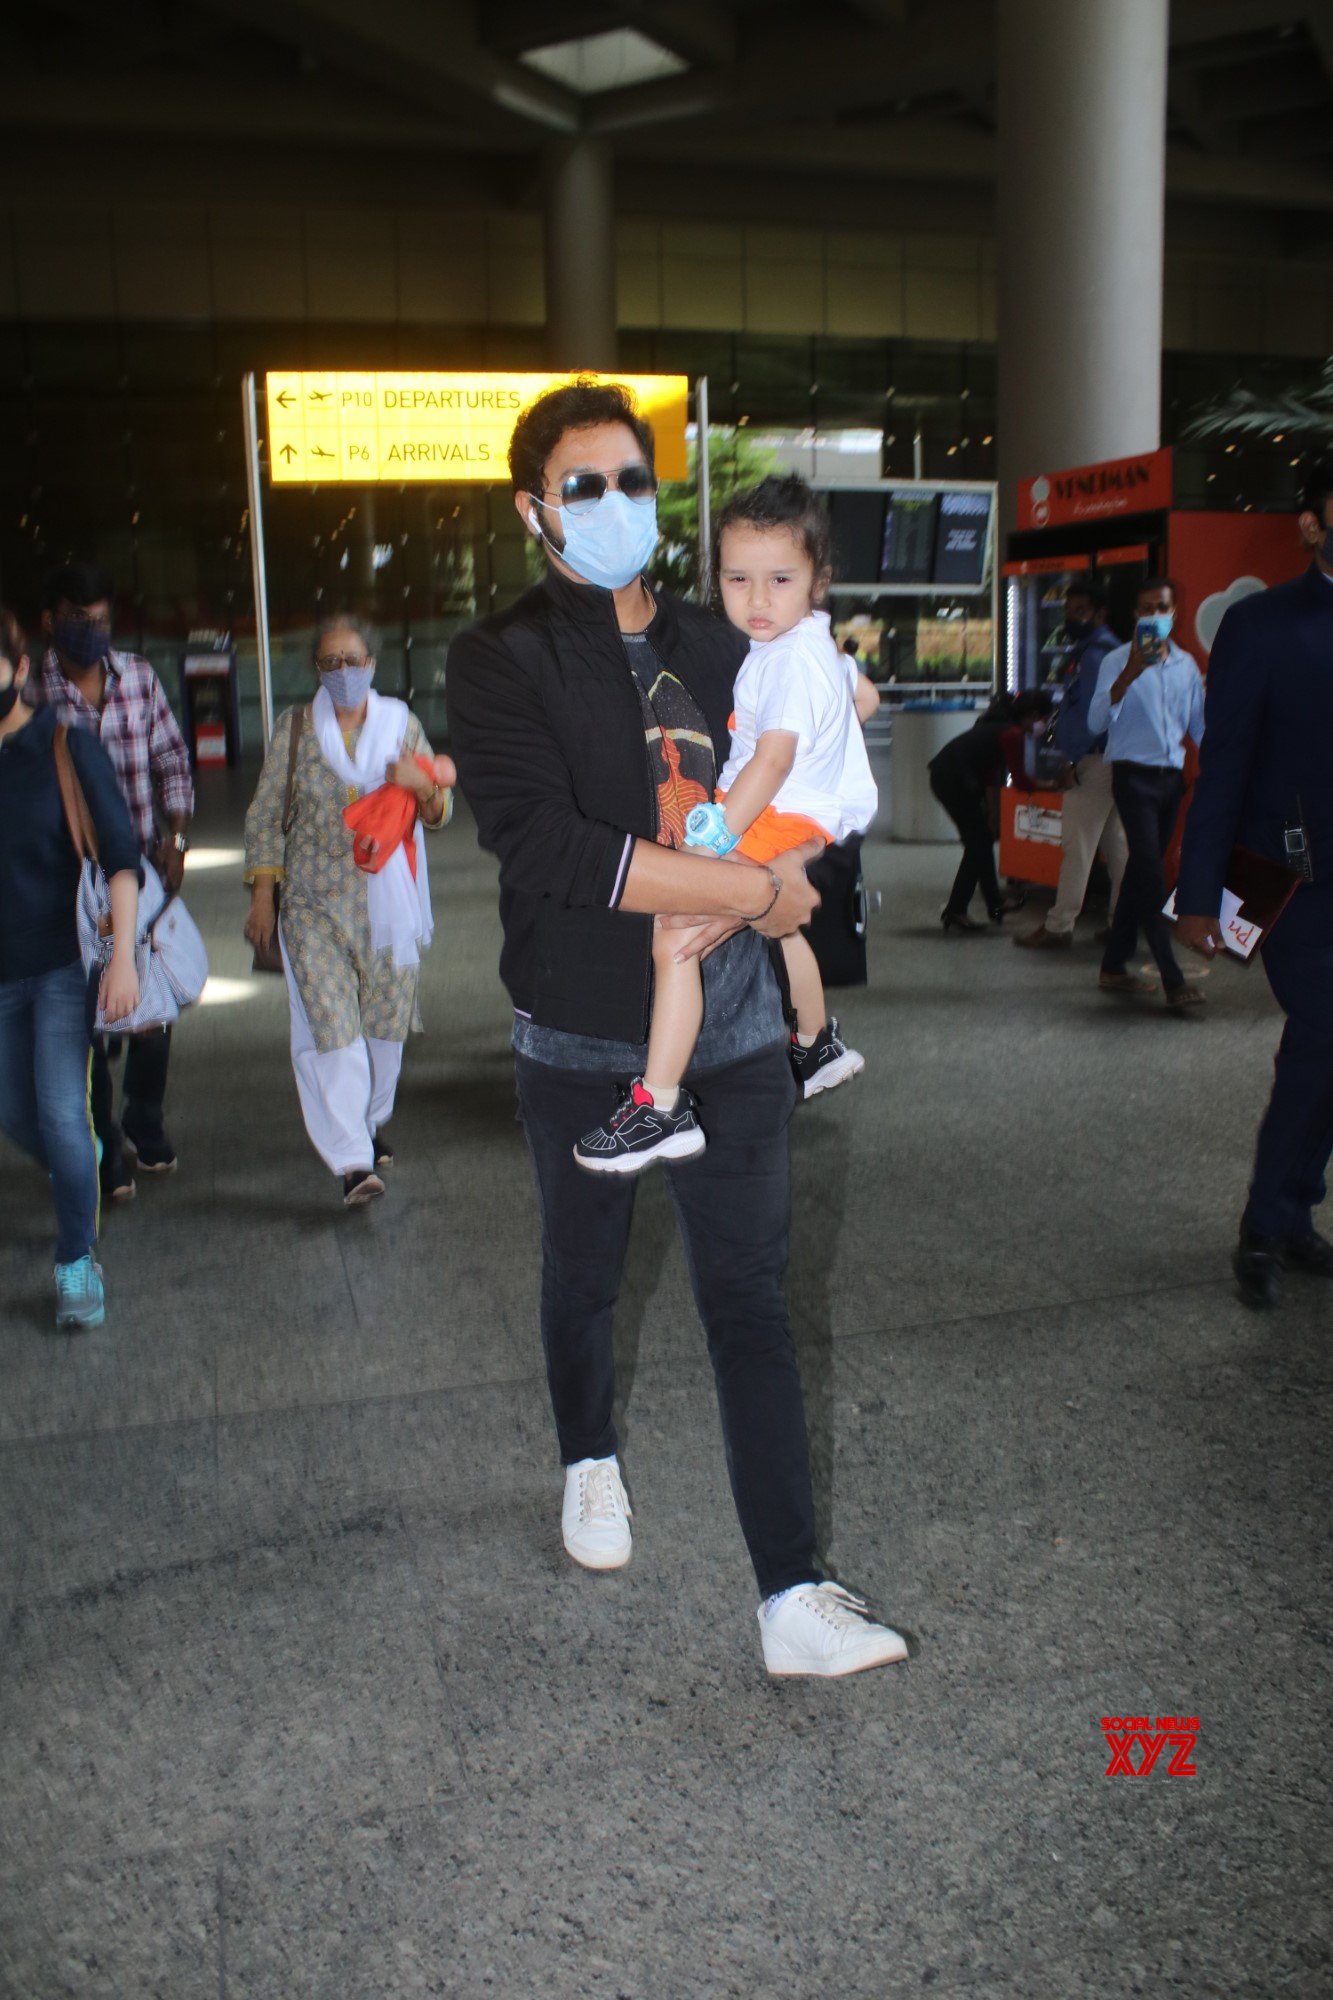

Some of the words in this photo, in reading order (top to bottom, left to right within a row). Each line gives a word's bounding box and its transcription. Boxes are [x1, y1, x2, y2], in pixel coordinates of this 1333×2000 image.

[341, 391, 373, 408] P10
[384, 390, 521, 409] DEPARTURES
[348, 445, 370, 461] P6
[387, 443, 490, 461] ARRIVALS
